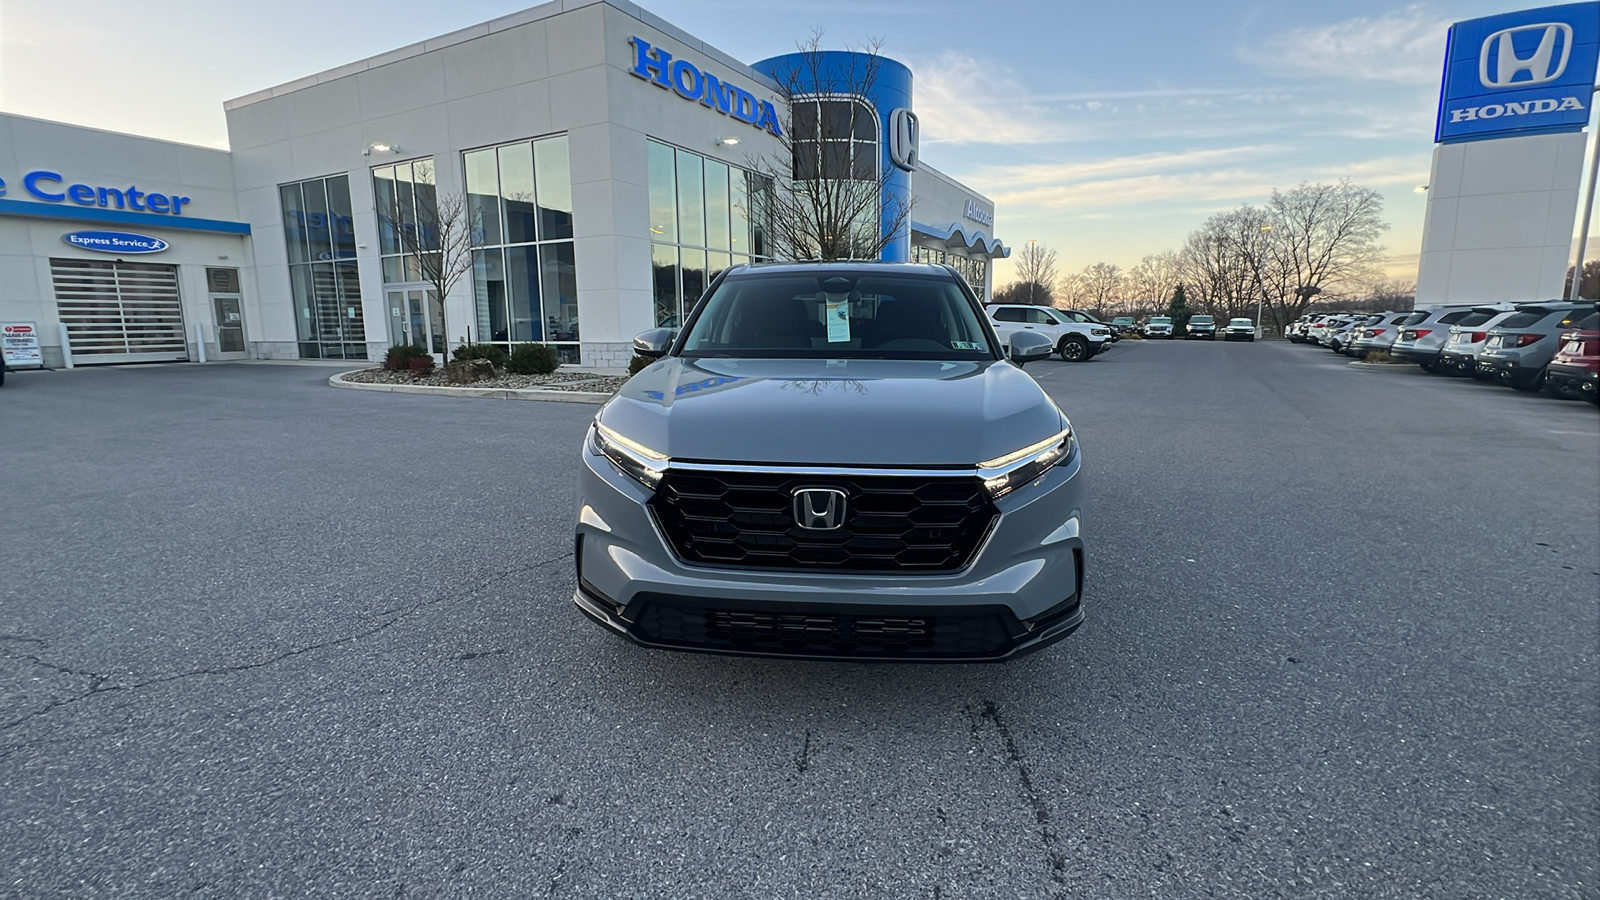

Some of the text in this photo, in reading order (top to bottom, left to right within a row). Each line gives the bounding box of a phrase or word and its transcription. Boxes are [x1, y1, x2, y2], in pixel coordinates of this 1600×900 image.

[628, 36, 783, 138] HONDA
[1450, 97, 1585, 123] HONDA
[23, 170, 190, 215] Center
[70, 235, 148, 247] Express Service
